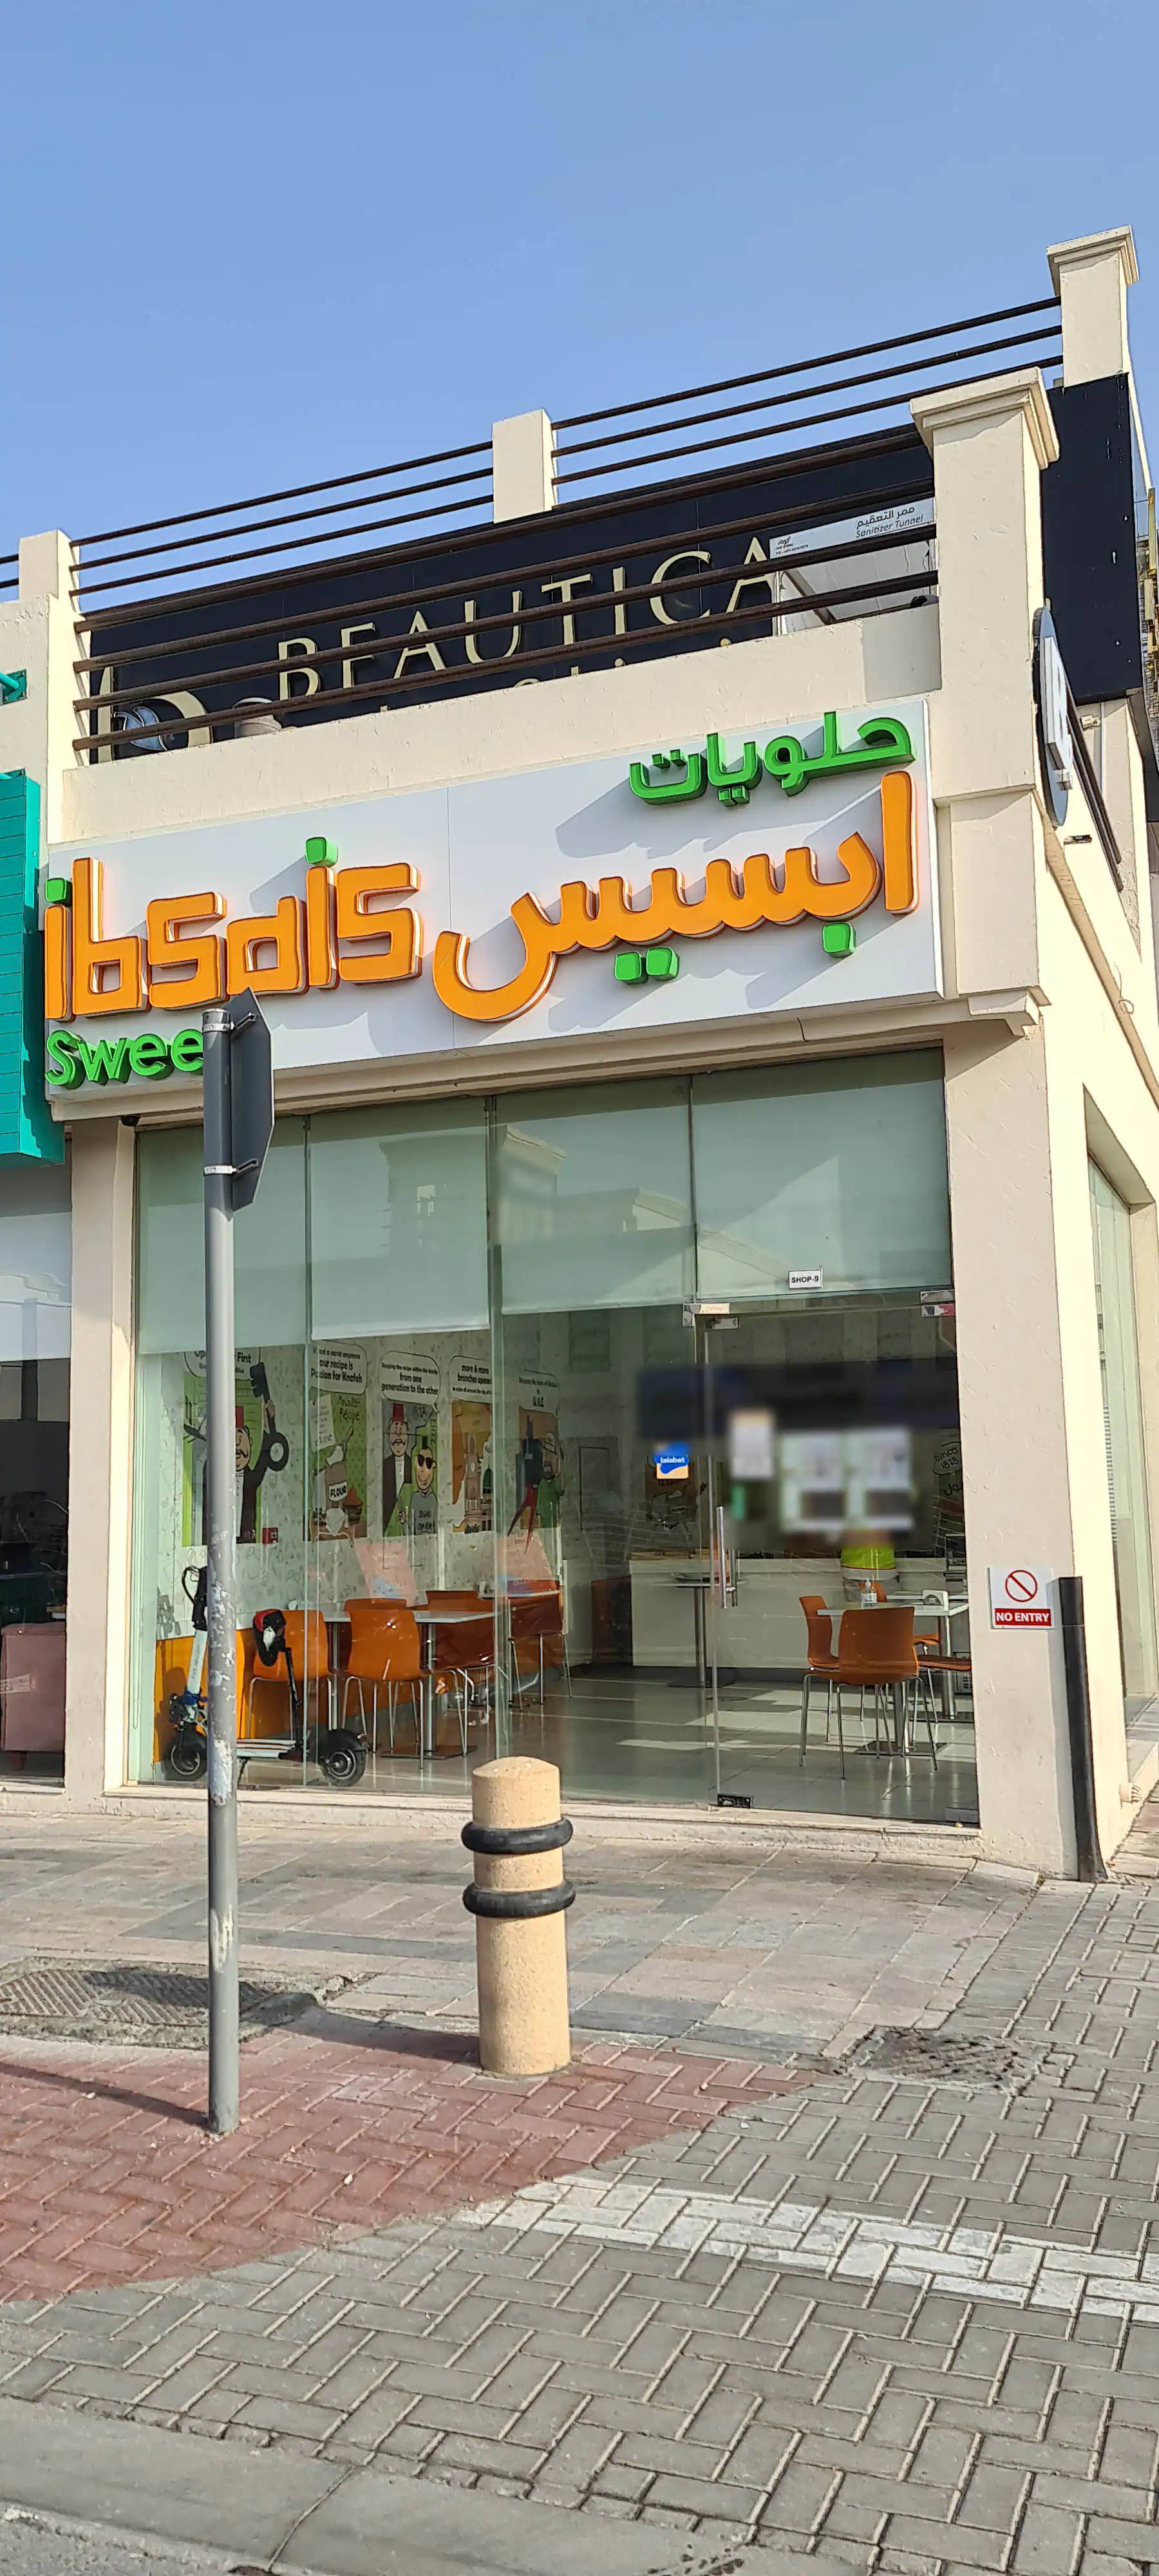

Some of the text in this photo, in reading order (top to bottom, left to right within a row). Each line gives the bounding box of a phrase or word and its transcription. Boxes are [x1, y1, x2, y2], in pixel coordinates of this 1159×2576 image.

[856, 507, 915, 529] ممر التعقيم
[856, 513, 923, 538] Sanitizer Tunnel
[278, 536, 777, 707] BEAUTICA
[628, 711, 917, 807] حلويات
[432, 770, 918, 1023] ابسيس
[44, 837, 422, 1022] ibsais
[45, 1028, 203, 1090] Swee
[791, 1275, 819, 1283] SHOP-9
[330, 1360, 348, 1370] recipe
[349, 1361, 353, 1370] is
[333, 1370, 341, 1381] for
[381, 1383, 410, 1392] generation
[330, 1484, 346, 1497] FLOUR
[995, 1612, 1050, 1622] NO ENTRY
